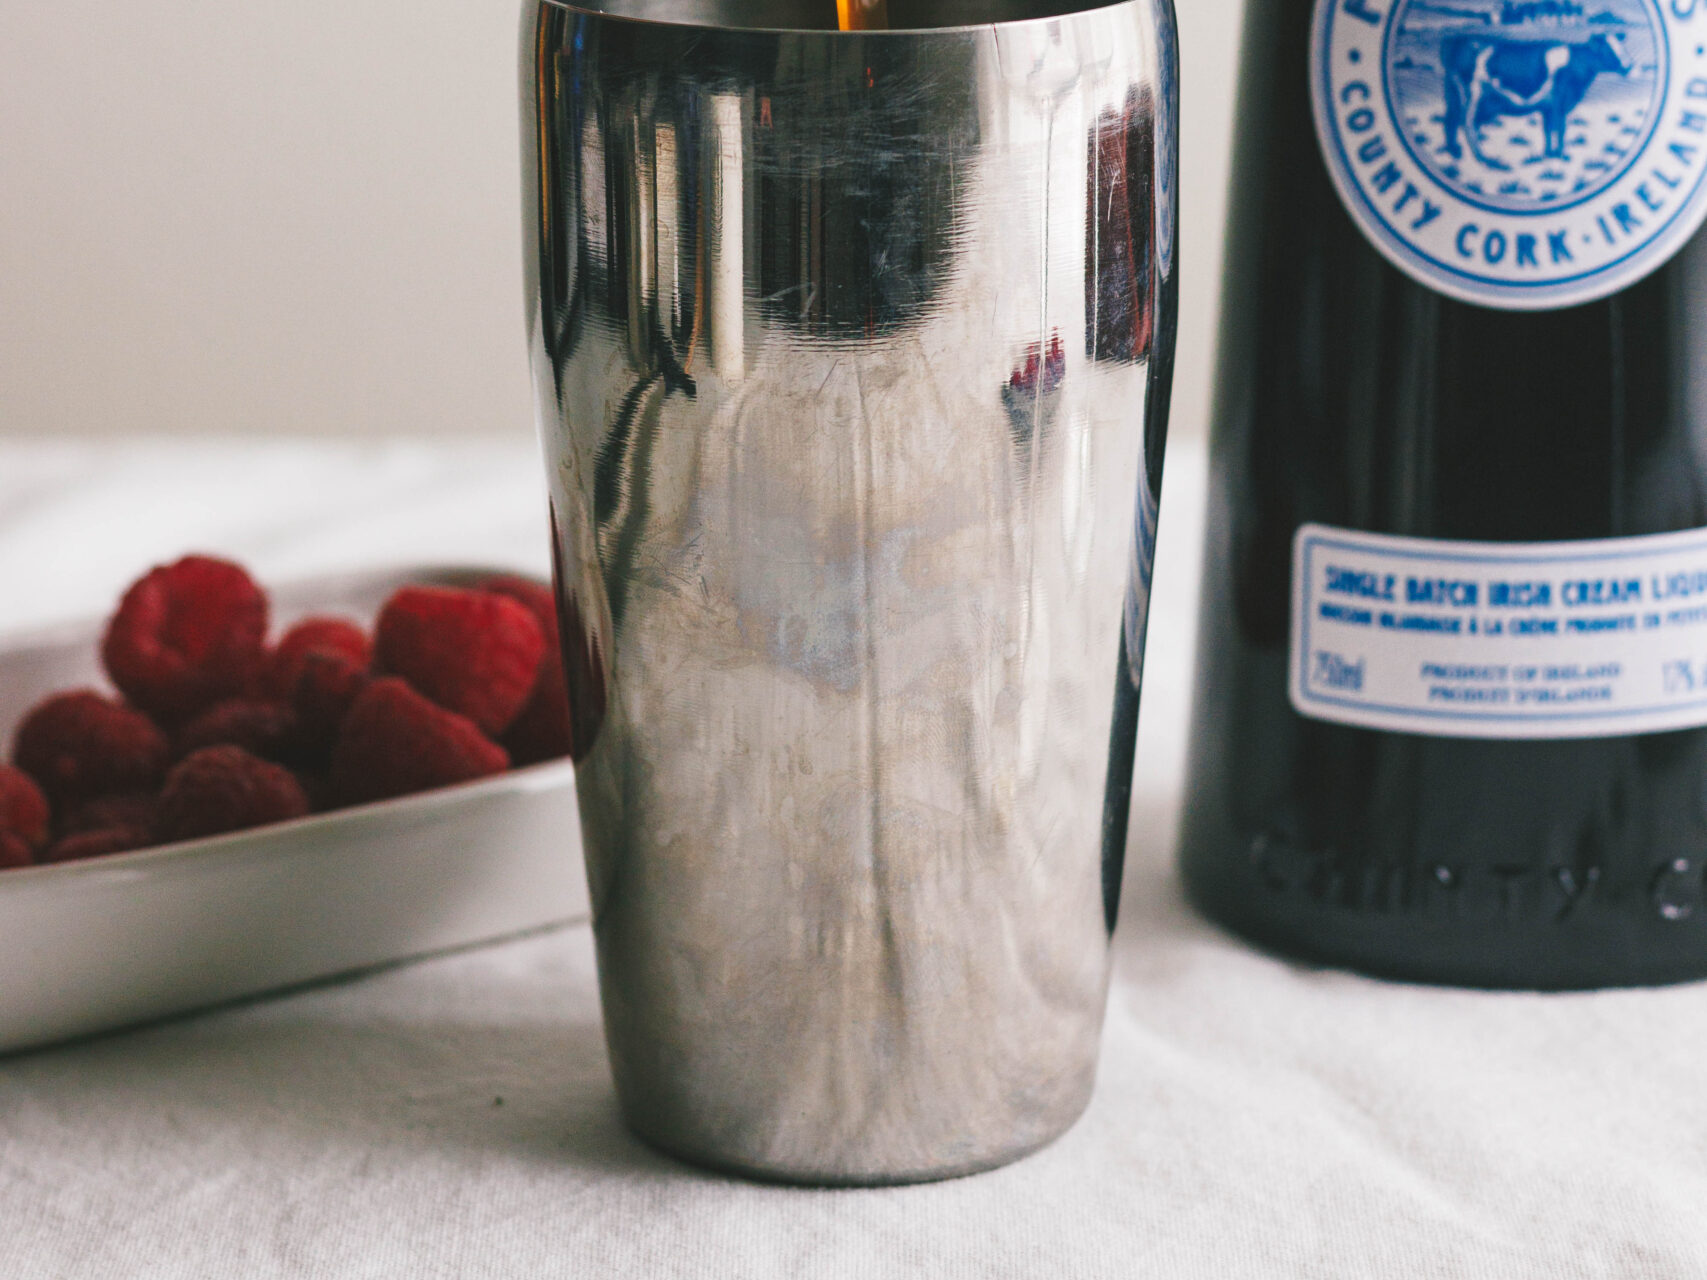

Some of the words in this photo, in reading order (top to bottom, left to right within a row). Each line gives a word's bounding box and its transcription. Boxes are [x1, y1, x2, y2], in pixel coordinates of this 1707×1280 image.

[1340, 81, 1442, 229] COUNTY
[1455, 224, 1574, 268] CORK
[1594, 75, 1707, 235] IRELAND
[1406, 576, 1479, 607] BATCH
[1561, 577, 1642, 607] CREAM
